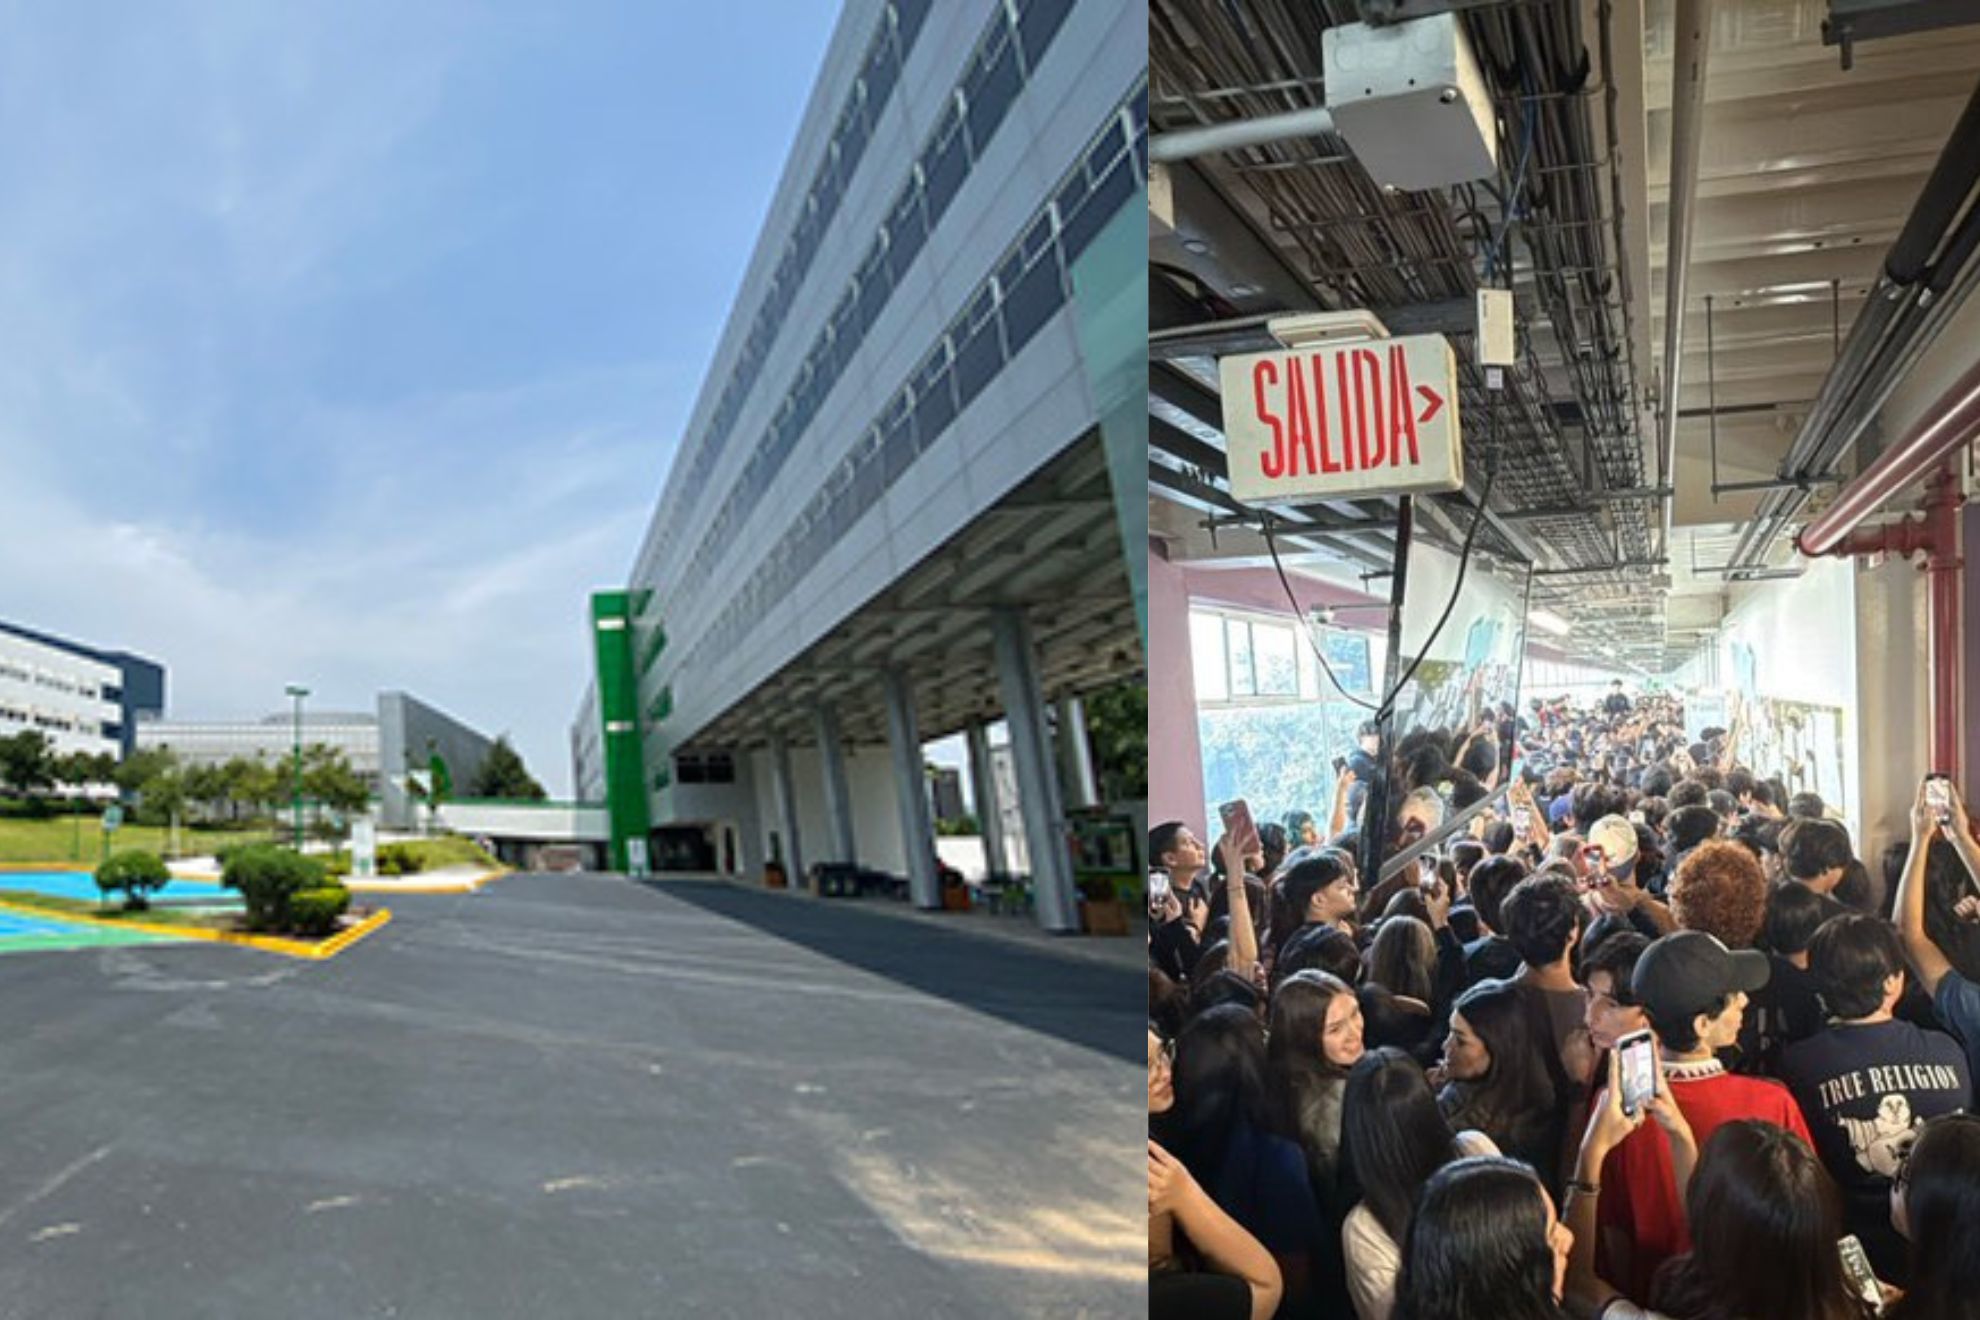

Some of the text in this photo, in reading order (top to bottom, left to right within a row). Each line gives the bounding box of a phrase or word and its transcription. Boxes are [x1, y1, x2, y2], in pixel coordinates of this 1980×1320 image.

[1254, 345, 1419, 478] SALIDA
[1819, 1064, 1960, 1108] TRUE RELIGION
